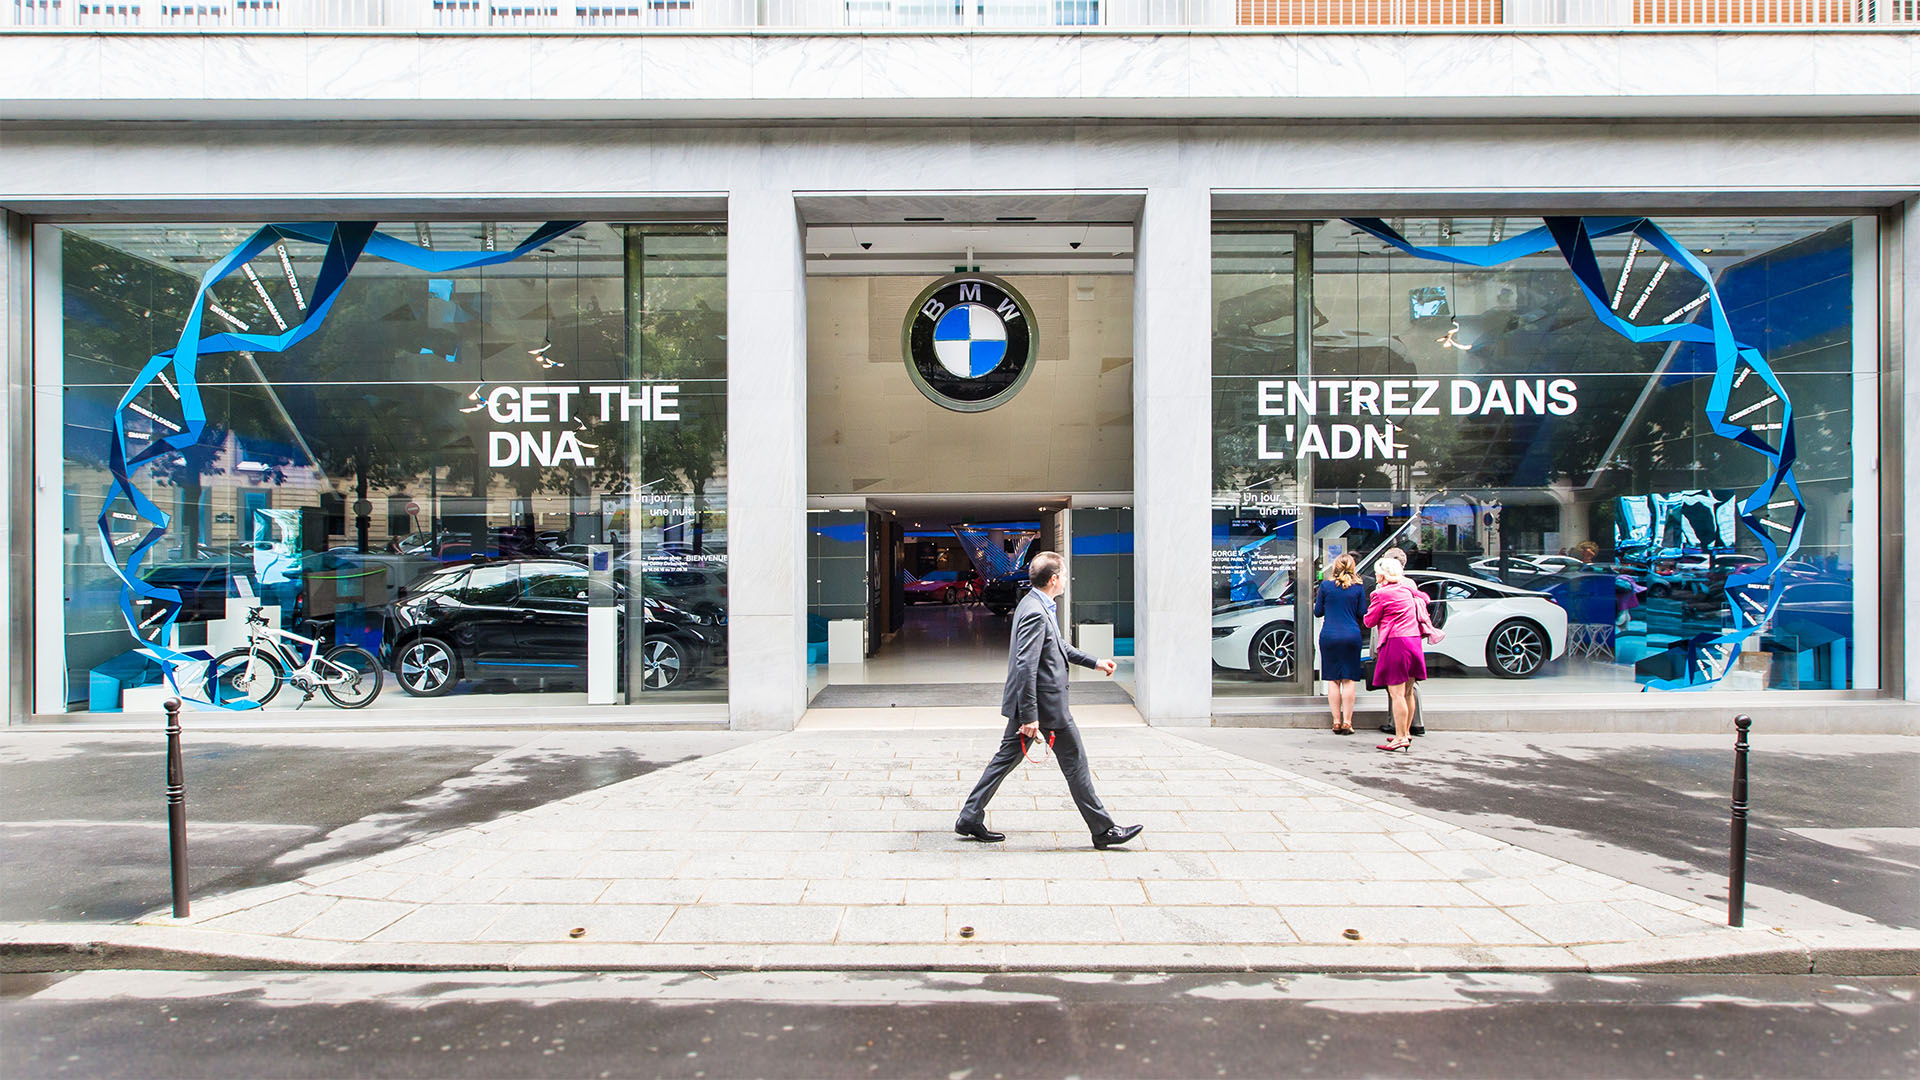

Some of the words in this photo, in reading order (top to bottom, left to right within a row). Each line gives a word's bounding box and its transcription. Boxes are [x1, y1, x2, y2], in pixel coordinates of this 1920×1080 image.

[277, 244, 299, 290] CONNECTED
[292, 288, 306, 311] DRIVE
[1628, 291, 1650, 320] DRIVING
[1644, 261, 1670, 296] PLEASURE
[209, 304, 250, 332] ENTHUSIASM
[921, 283, 1021, 322] BMW
[1682, 291, 1710, 313] MOBILITY
[487, 386, 580, 423] GET
[589, 385, 680, 422] THE
[1257, 380, 1440, 416] ENTREZ
[1450, 379, 1578, 416] DANS
[488, 431, 595, 468] DNA.
[1257, 424, 1407, 460] L'ADN.
[634, 493, 648, 504] Un
[650, 508, 669, 517] une
[1243, 493, 1258, 502] Un
[1259, 507, 1278, 516] une
[686, 554, 728, 562] BIENVENUE
